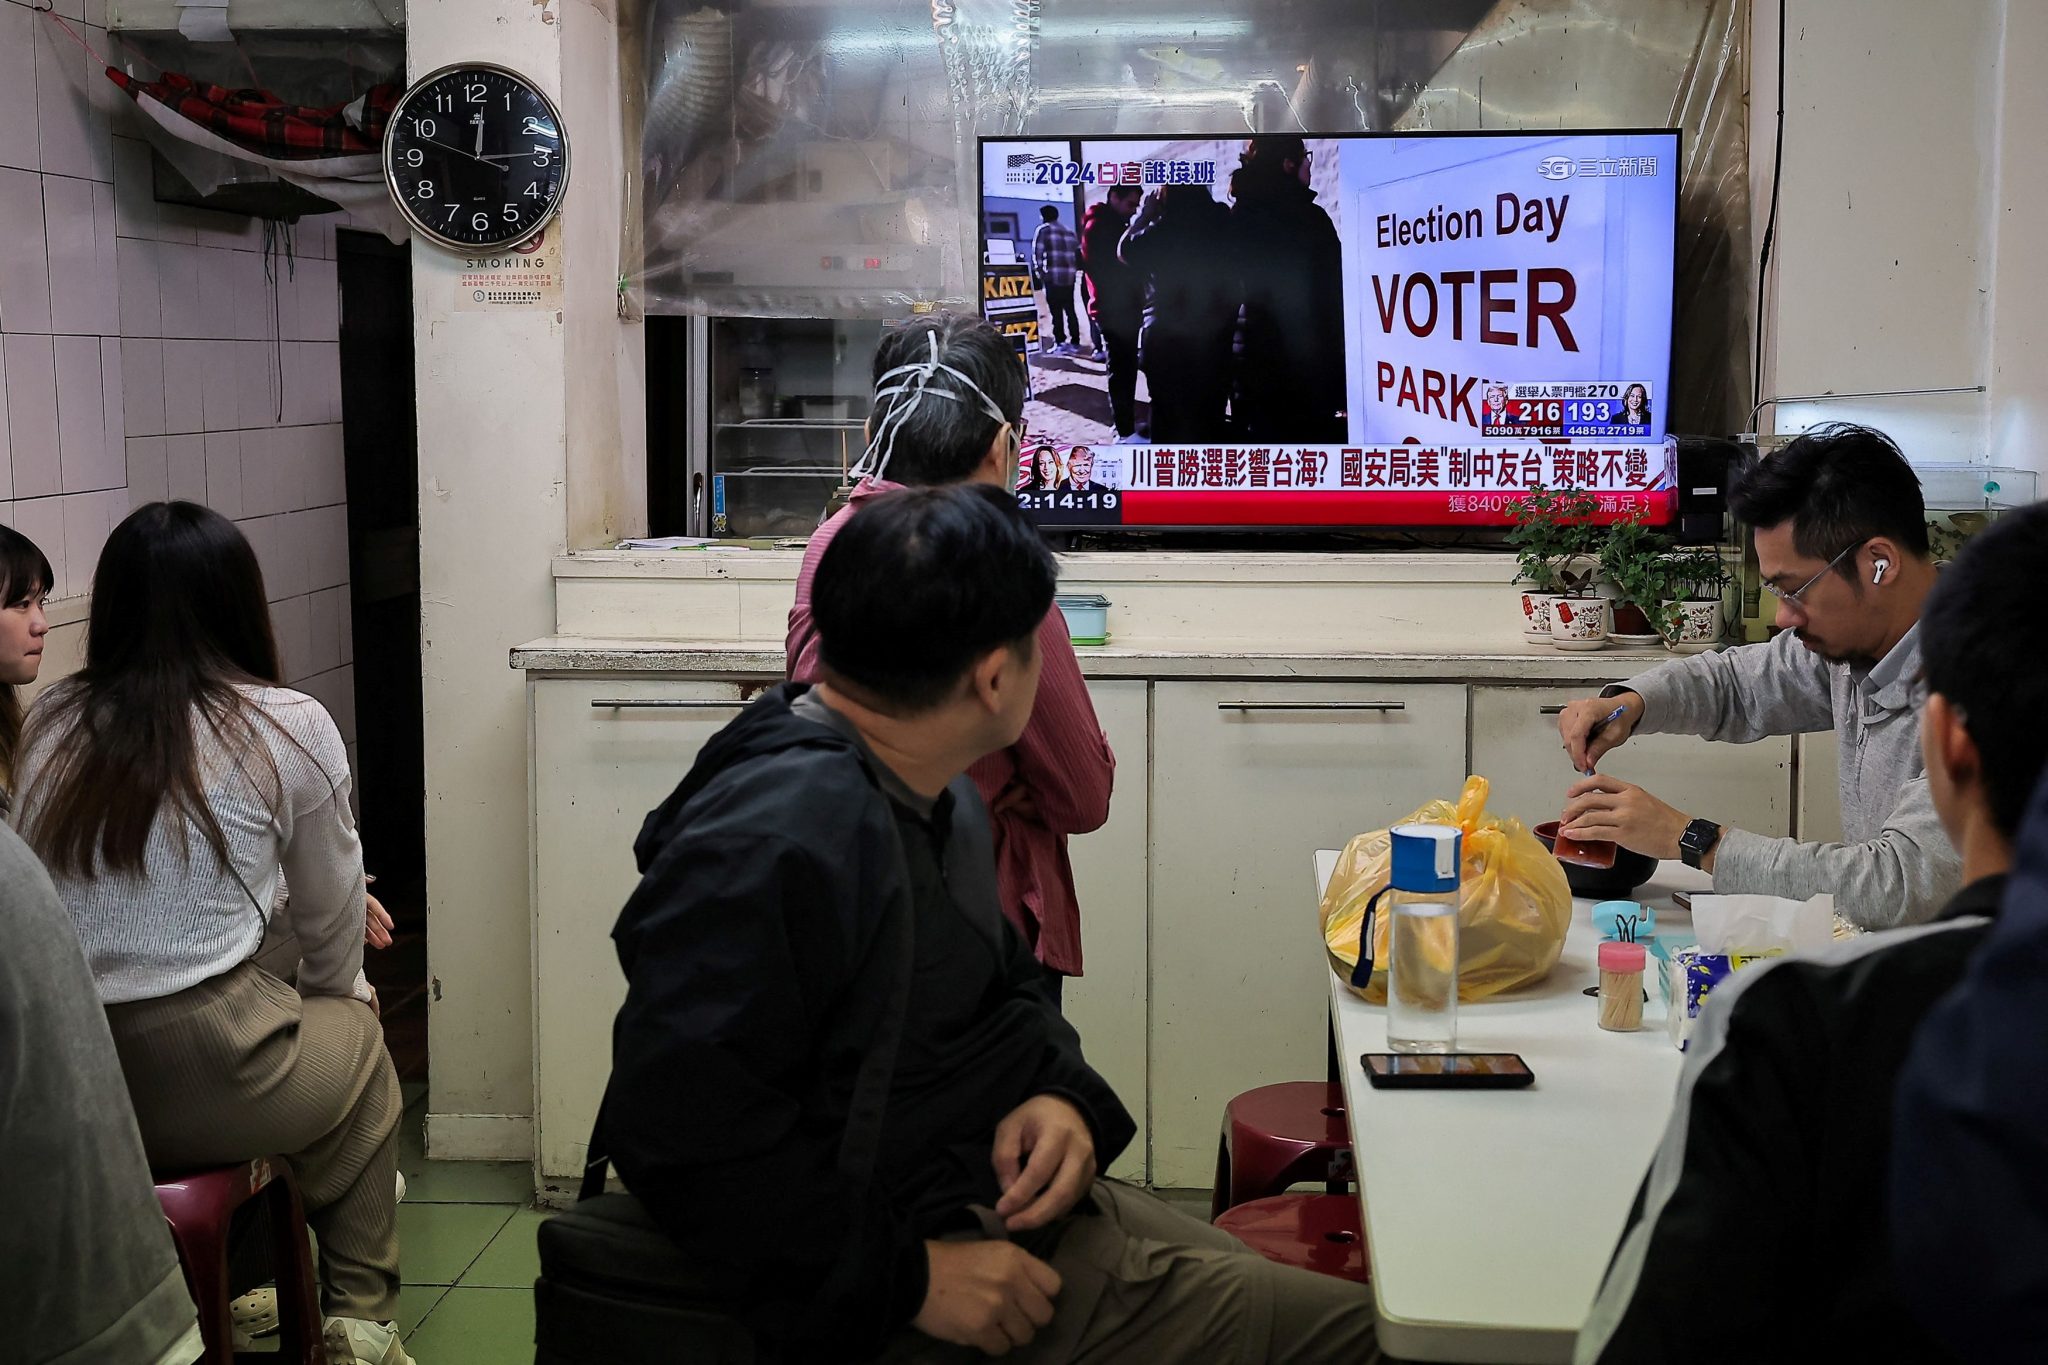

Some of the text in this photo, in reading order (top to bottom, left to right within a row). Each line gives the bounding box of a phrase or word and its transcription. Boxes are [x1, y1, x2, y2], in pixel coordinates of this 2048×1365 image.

[436, 94, 452, 112] 11
[464, 84, 488, 103] 12
[504, 92, 511, 111] 1
[413, 119, 436, 138] 10
[522, 116, 539, 135] 2
[407, 148, 424, 167] 9
[533, 149, 549, 167] 3
[1578, 157, 1657, 177] 三立新聞
[1035, 161, 1216, 185] 2024白宮誰接班
[417, 180, 434, 199] 8
[523, 181, 540, 199] 4
[444, 204, 460, 222] 7
[472, 212, 489, 231] 6
[503, 203, 519, 222] 5
[1377, 192, 1569, 248] Election Day
[466, 258, 545, 269] SMOKING
[984, 276, 1031, 298] KATZ
[1371, 268, 1580, 353] VOTER
[1377, 360, 1504, 428] PARK
[1515, 384, 1619, 398] 選舉人票門檻270
[1518, 402, 1560, 421] 216
[1567, 402, 1610, 422] 193
[1485, 426, 1561, 436] 5090萬7916票
[1568, 426, 1645, 436] 4485萬2719票
[1131, 449, 1328, 488] 川普勝選影響台海?
